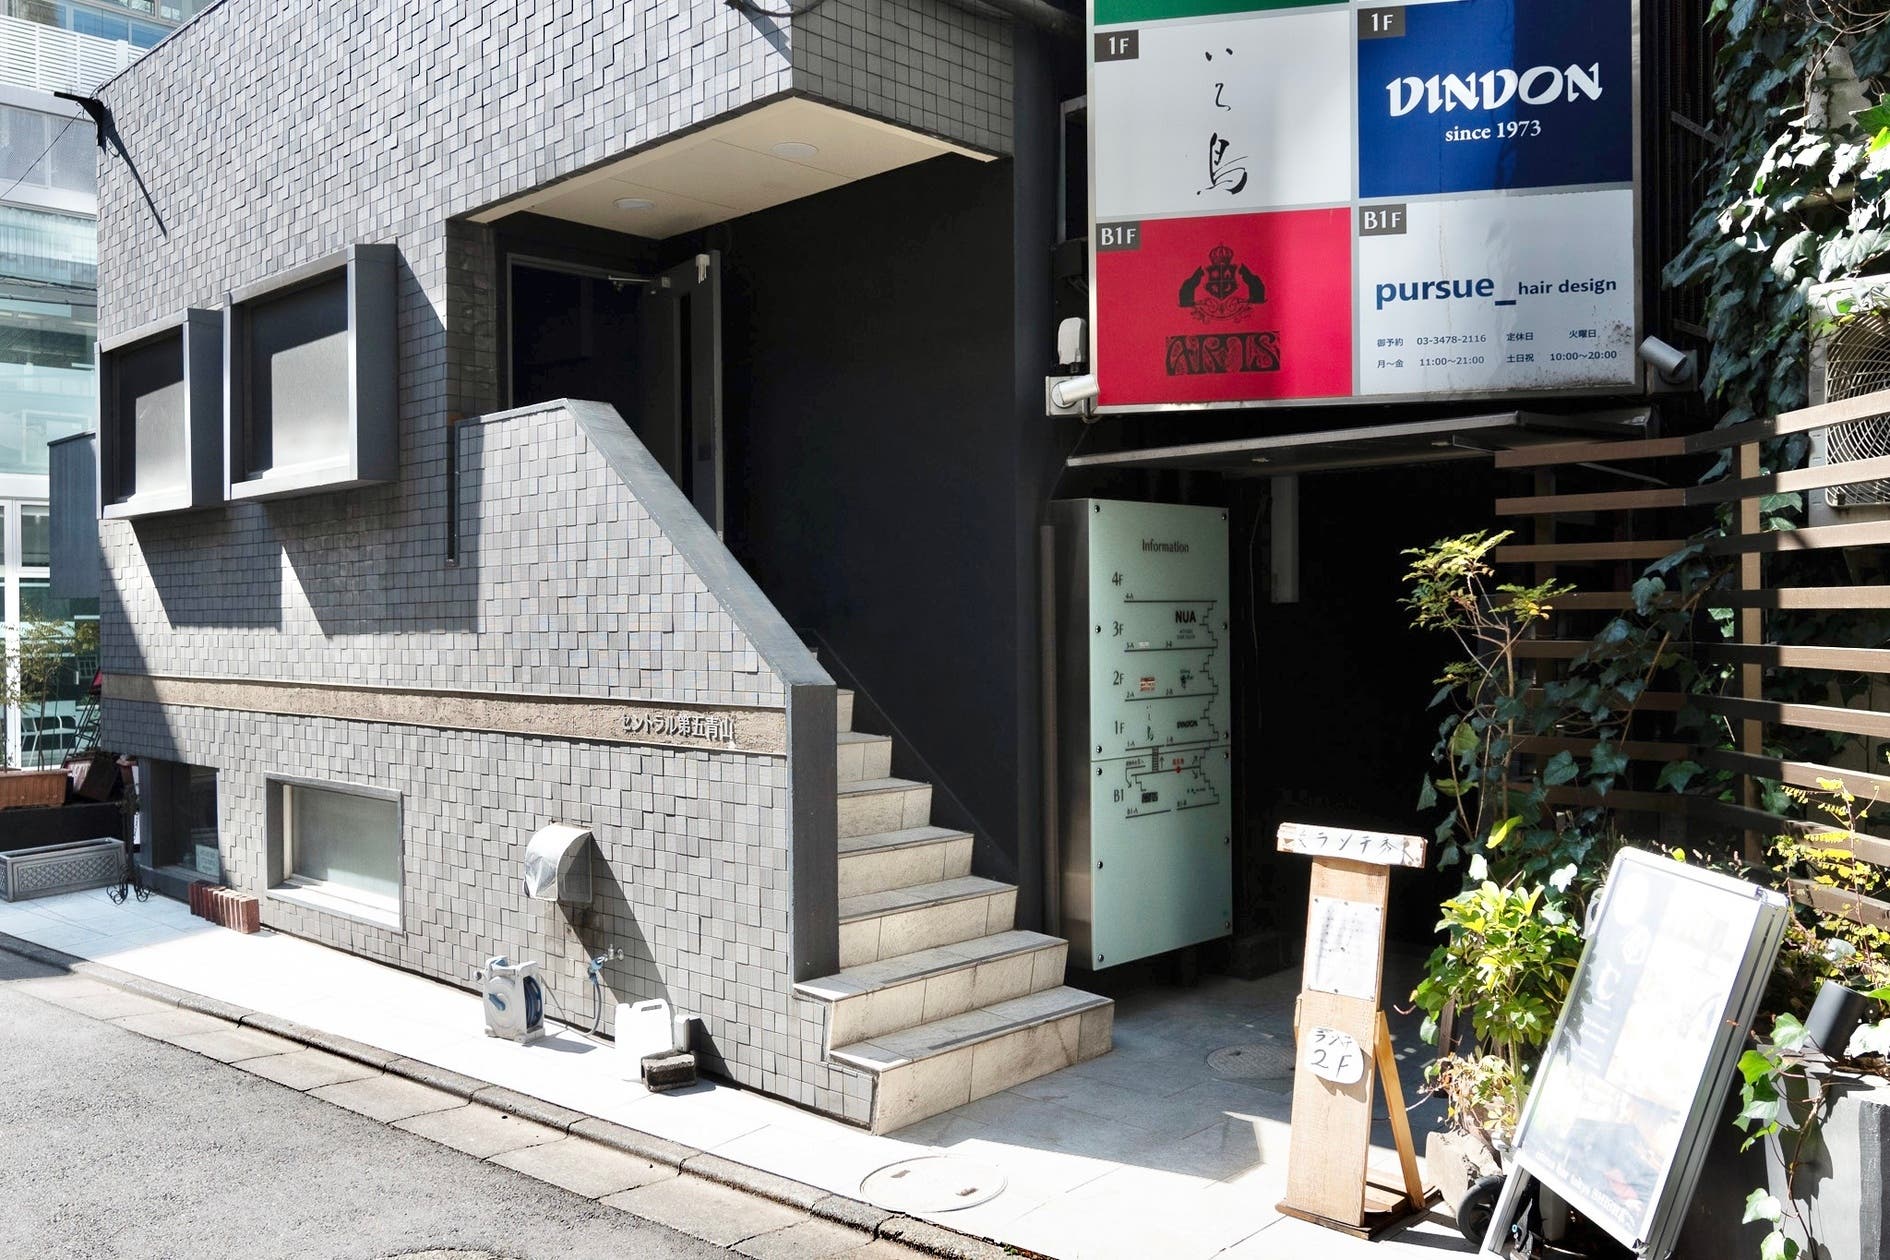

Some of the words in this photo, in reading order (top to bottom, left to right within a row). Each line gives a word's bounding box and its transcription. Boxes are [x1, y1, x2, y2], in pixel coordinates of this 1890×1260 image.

[1370, 12, 1394, 32] 1F
[1106, 36, 1130, 56] 1F
[1385, 61, 1603, 118] DINDON
[1444, 125, 1492, 142] since
[1496, 119, 1542, 139] 1973
[1362, 210, 1403, 230] B1F
[1101, 228, 1137, 246] B1F
[1517, 280, 1553, 296] hair
[1557, 278, 1617, 298] design
[1376, 337, 1404, 348] 御予約
[1416, 334, 1487, 346] 03-3478-2116
[1506, 331, 1534, 342] 定休日
[1568, 328, 1597, 339] 火曜日
[1506, 353, 1535, 364] 土日祝
[1142, 538, 1190, 553] Information
[1111, 571, 1124, 587] 4F
[1175, 610, 1197, 624] NUA
[1112, 621, 1124, 637] 3F
[1112, 670, 1125, 686] 2F
[1114, 720, 1125, 735] 1F
[1113, 789, 1124, 803] B1
